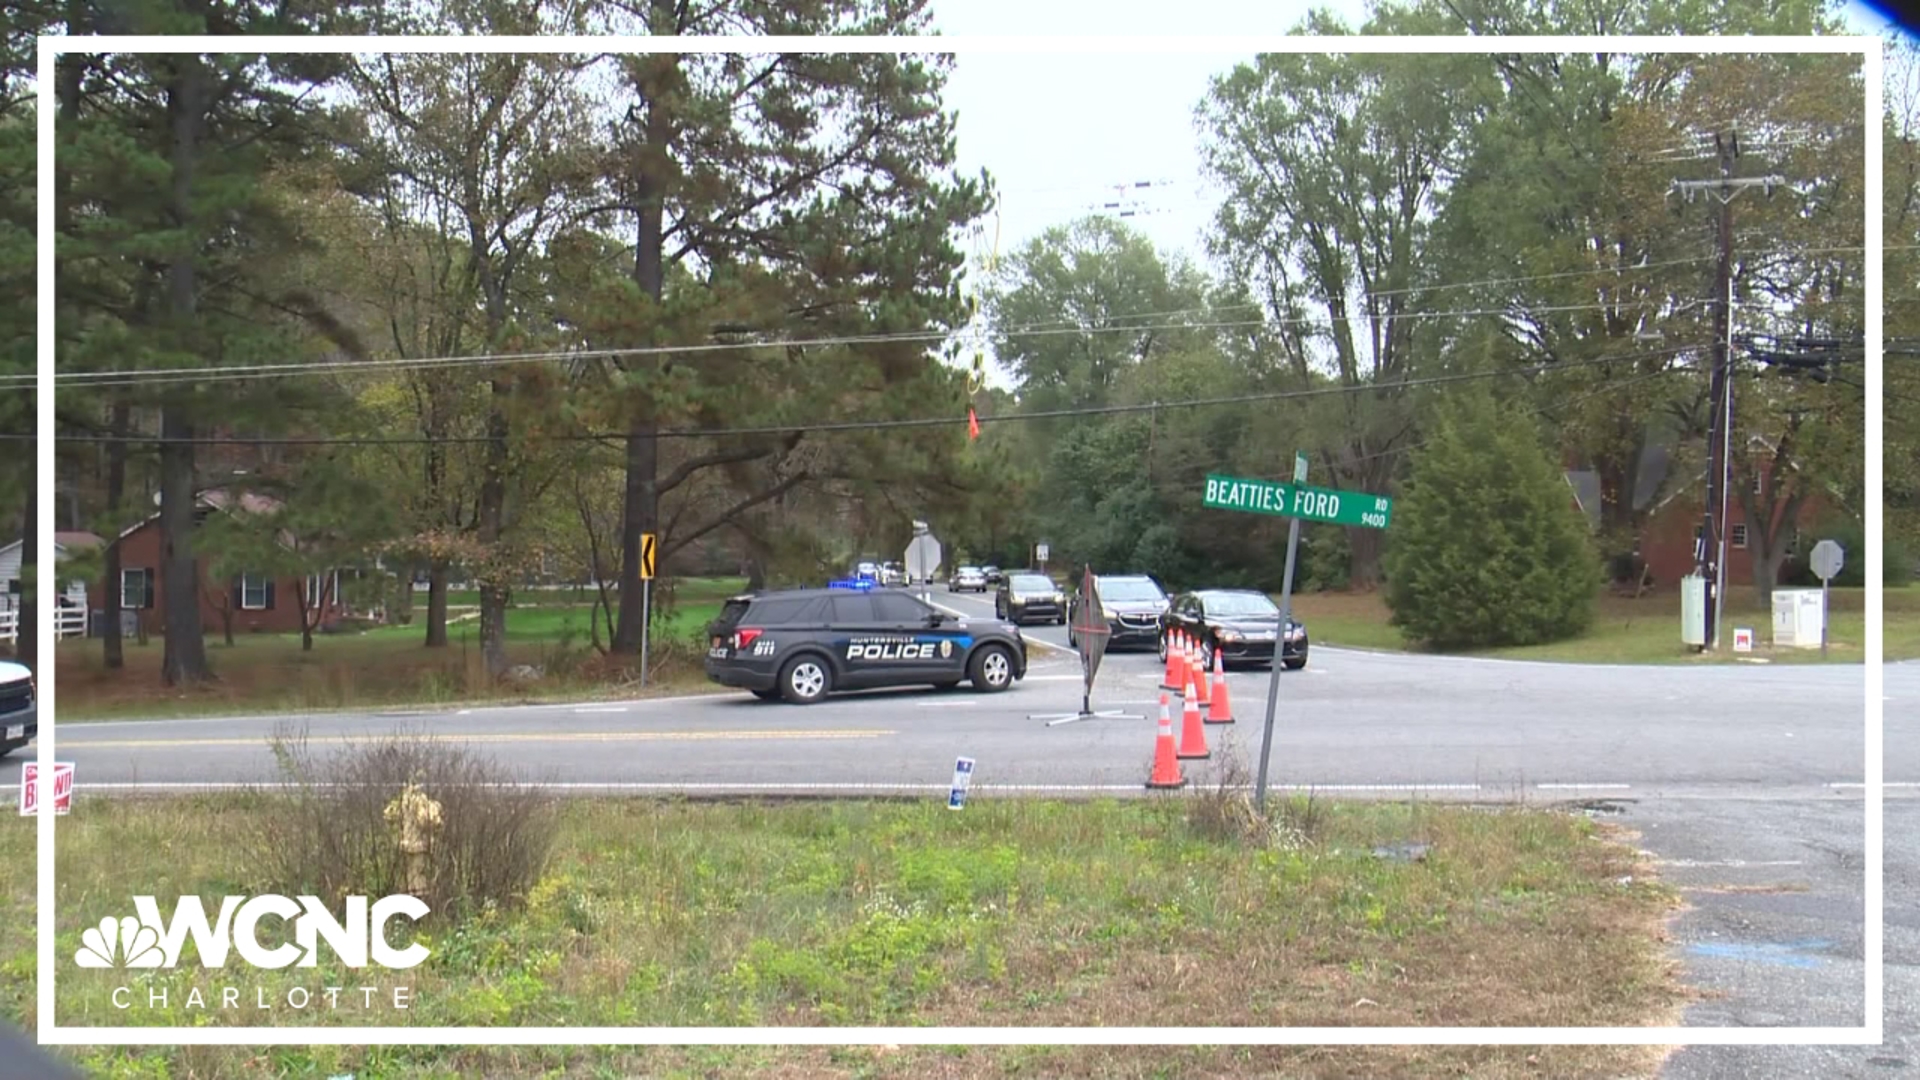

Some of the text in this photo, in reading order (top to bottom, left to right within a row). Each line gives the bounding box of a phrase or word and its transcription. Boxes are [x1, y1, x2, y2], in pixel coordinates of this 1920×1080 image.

[1206, 479, 1388, 518] BEATTIES FORD RD
[1361, 512, 1387, 527] 9400
[753, 645, 775, 656] 911
[846, 643, 936, 660] POLICE
